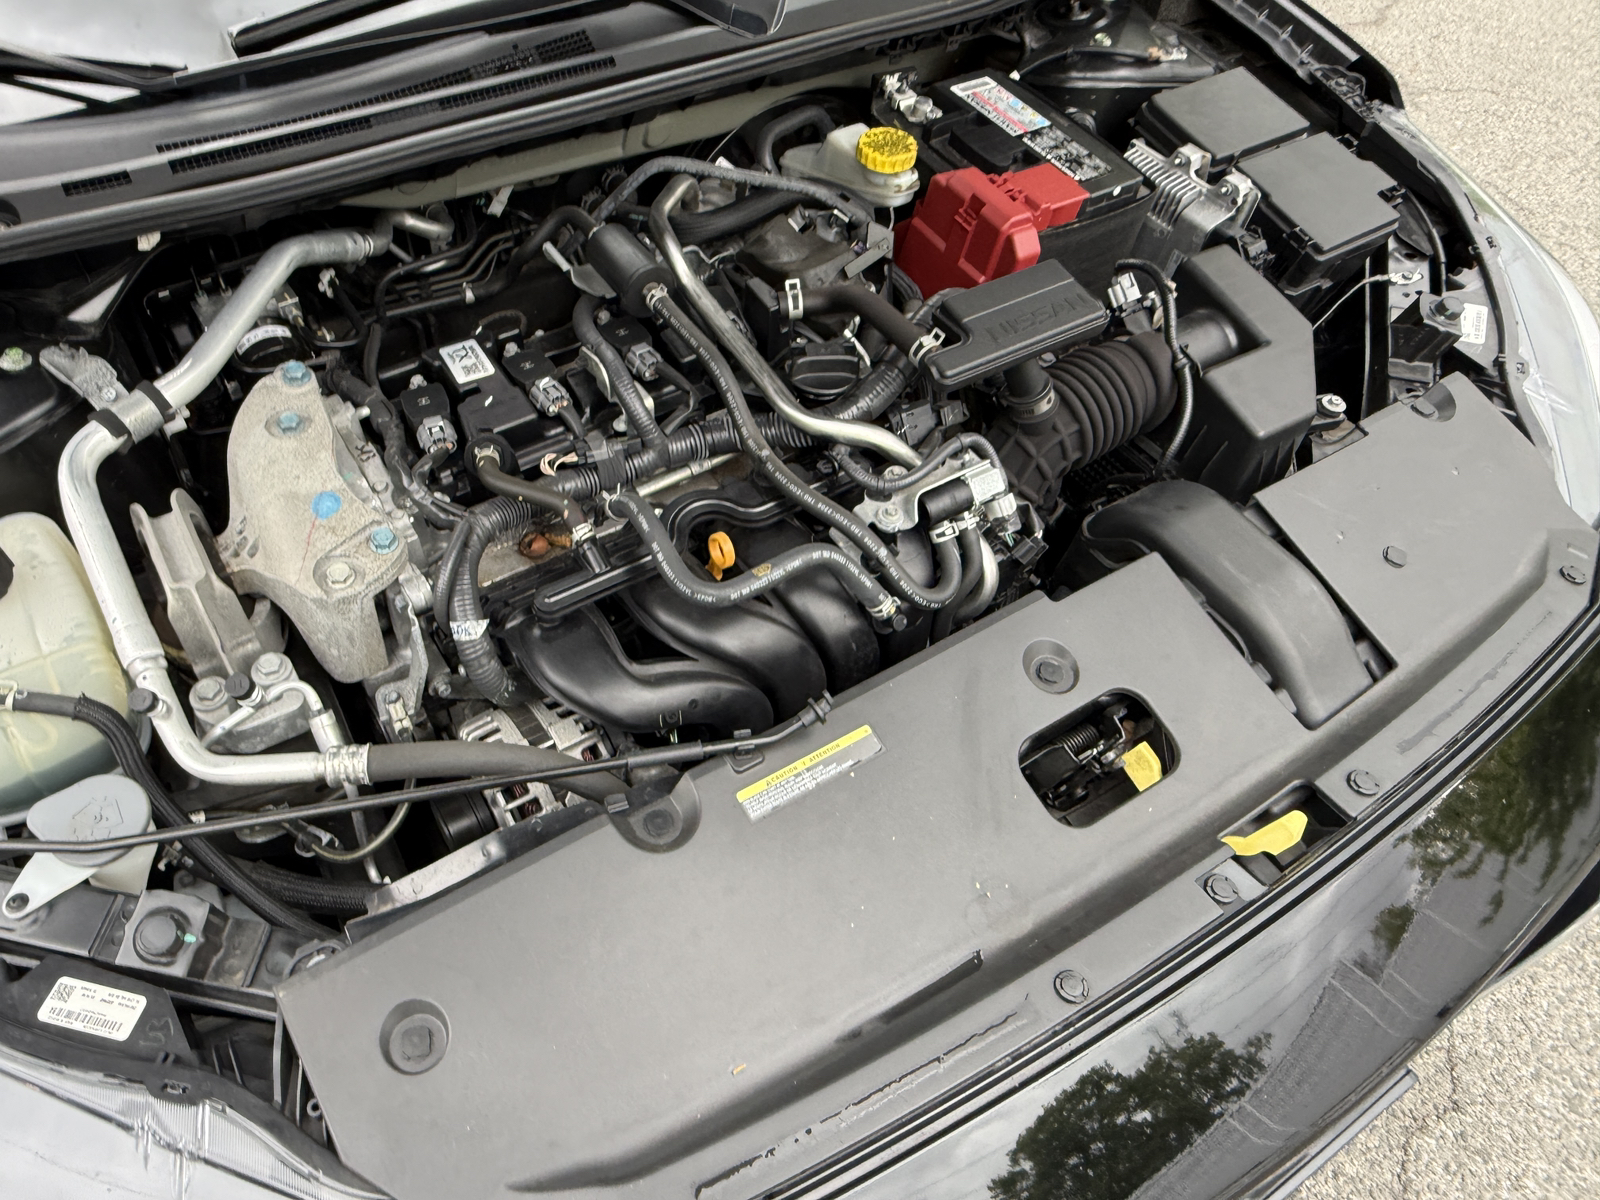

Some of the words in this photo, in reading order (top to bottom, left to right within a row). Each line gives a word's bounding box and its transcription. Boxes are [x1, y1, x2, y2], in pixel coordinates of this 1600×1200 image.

[984, 293, 1091, 344] NISSAN
[771, 766, 798, 783] CAUTION
[809, 743, 841, 763] ATTENTION
